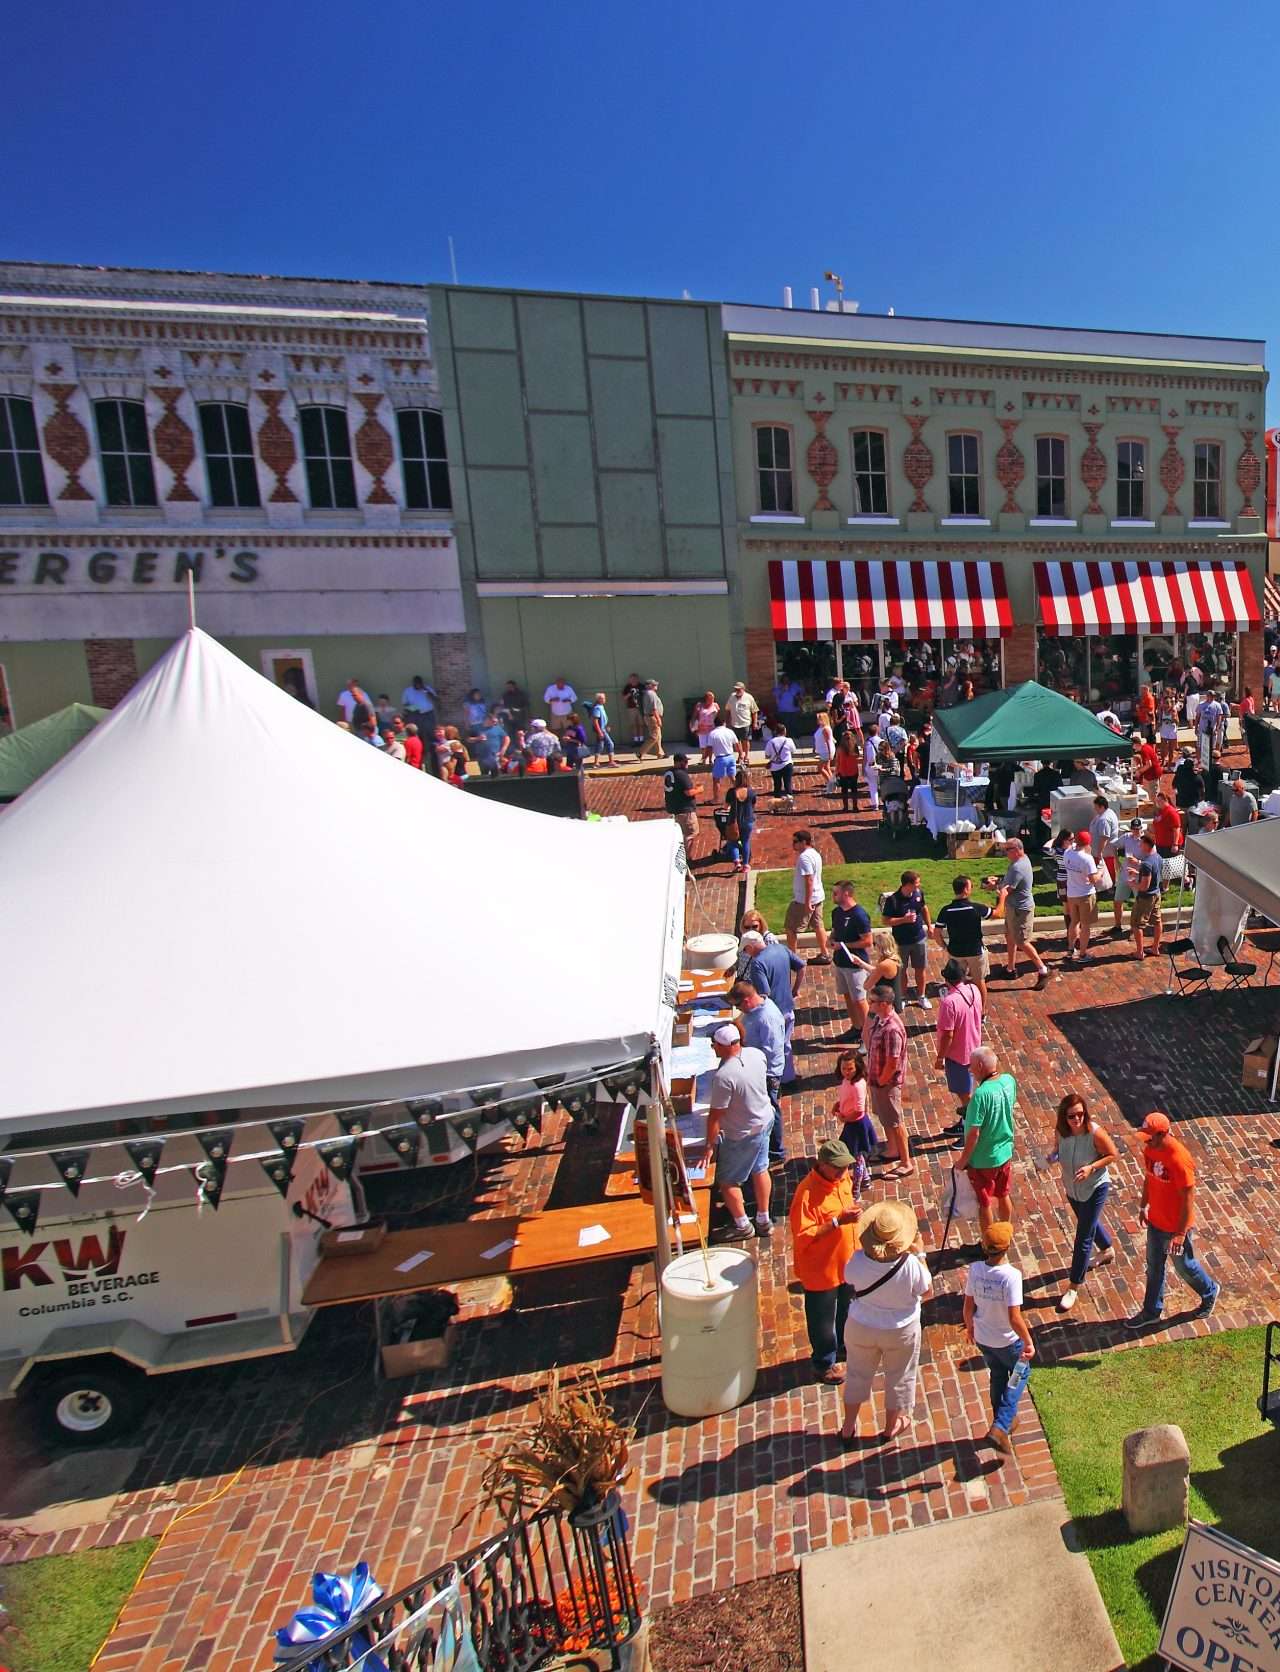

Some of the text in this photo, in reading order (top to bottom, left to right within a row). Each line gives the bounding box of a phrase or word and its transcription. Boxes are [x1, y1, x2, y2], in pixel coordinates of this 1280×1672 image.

[0, 549, 259, 585] ERGEN'S
[2, 1230, 127, 1291] KW
[68, 1271, 160, 1296] BEVERAGE
[19, 1292, 134, 1317] Columbia S.C.
[1176, 1625, 1268, 1672] OPE
